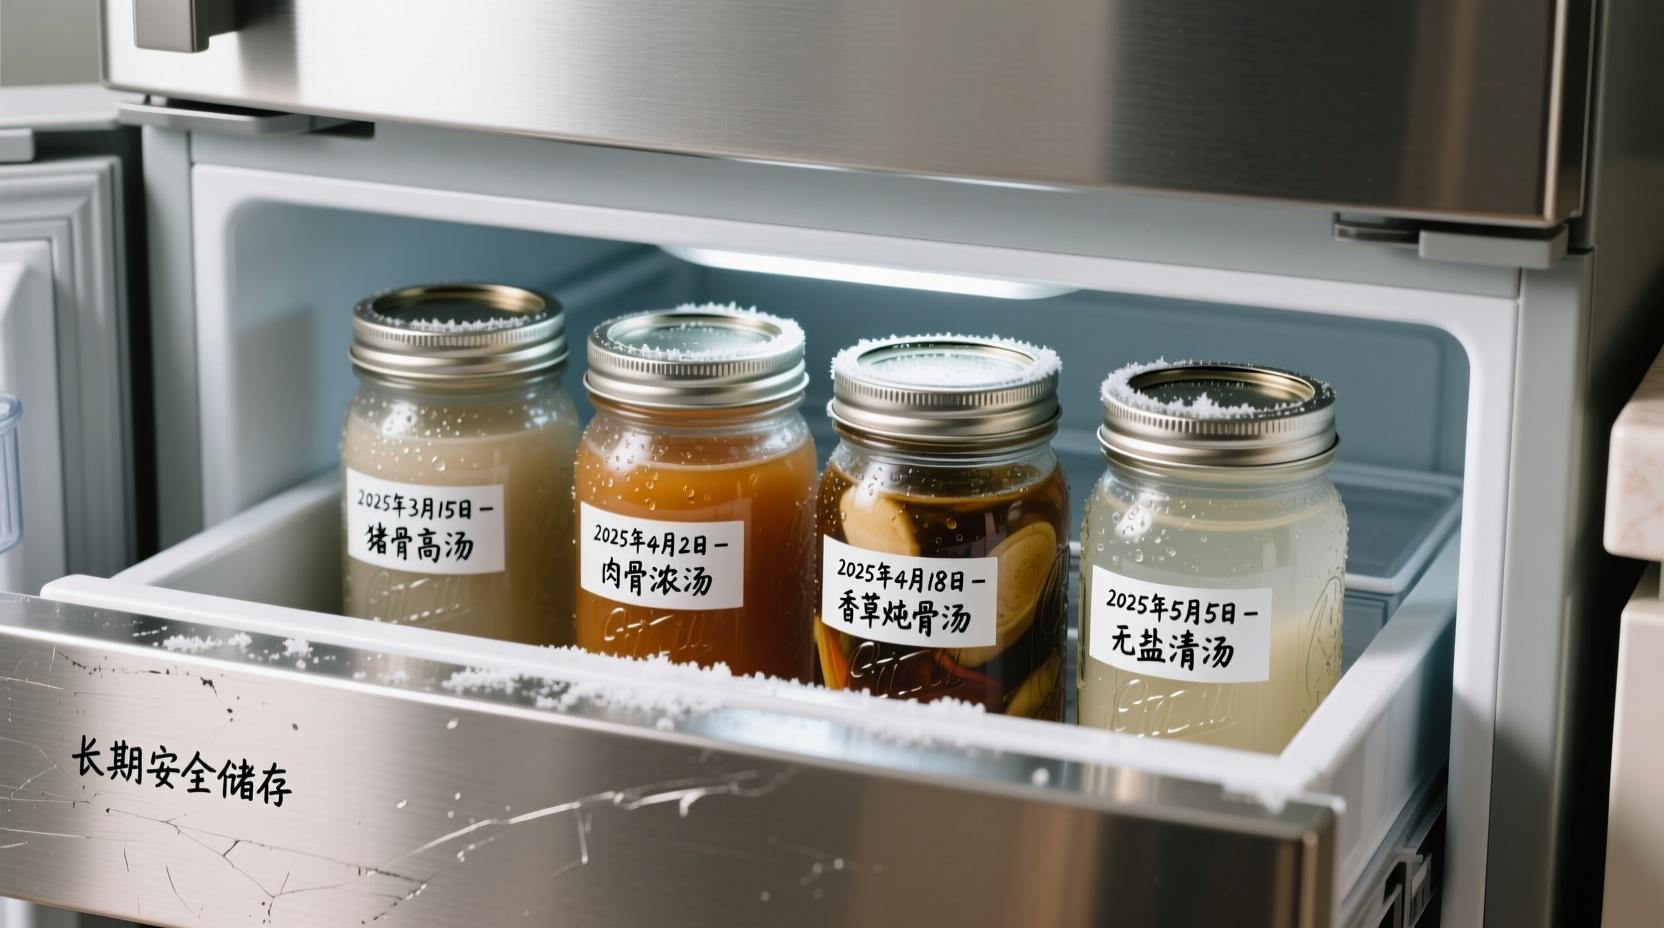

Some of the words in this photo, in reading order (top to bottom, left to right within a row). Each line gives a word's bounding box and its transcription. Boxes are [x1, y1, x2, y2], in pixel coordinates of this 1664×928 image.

[601, 556, 713, 597] 肉骨浓汤
[838, 590, 972, 638] 香草炖骨汤
[1111, 624, 1235, 672] 无盐清汤
[71, 734, 293, 807] 长期安全储存
